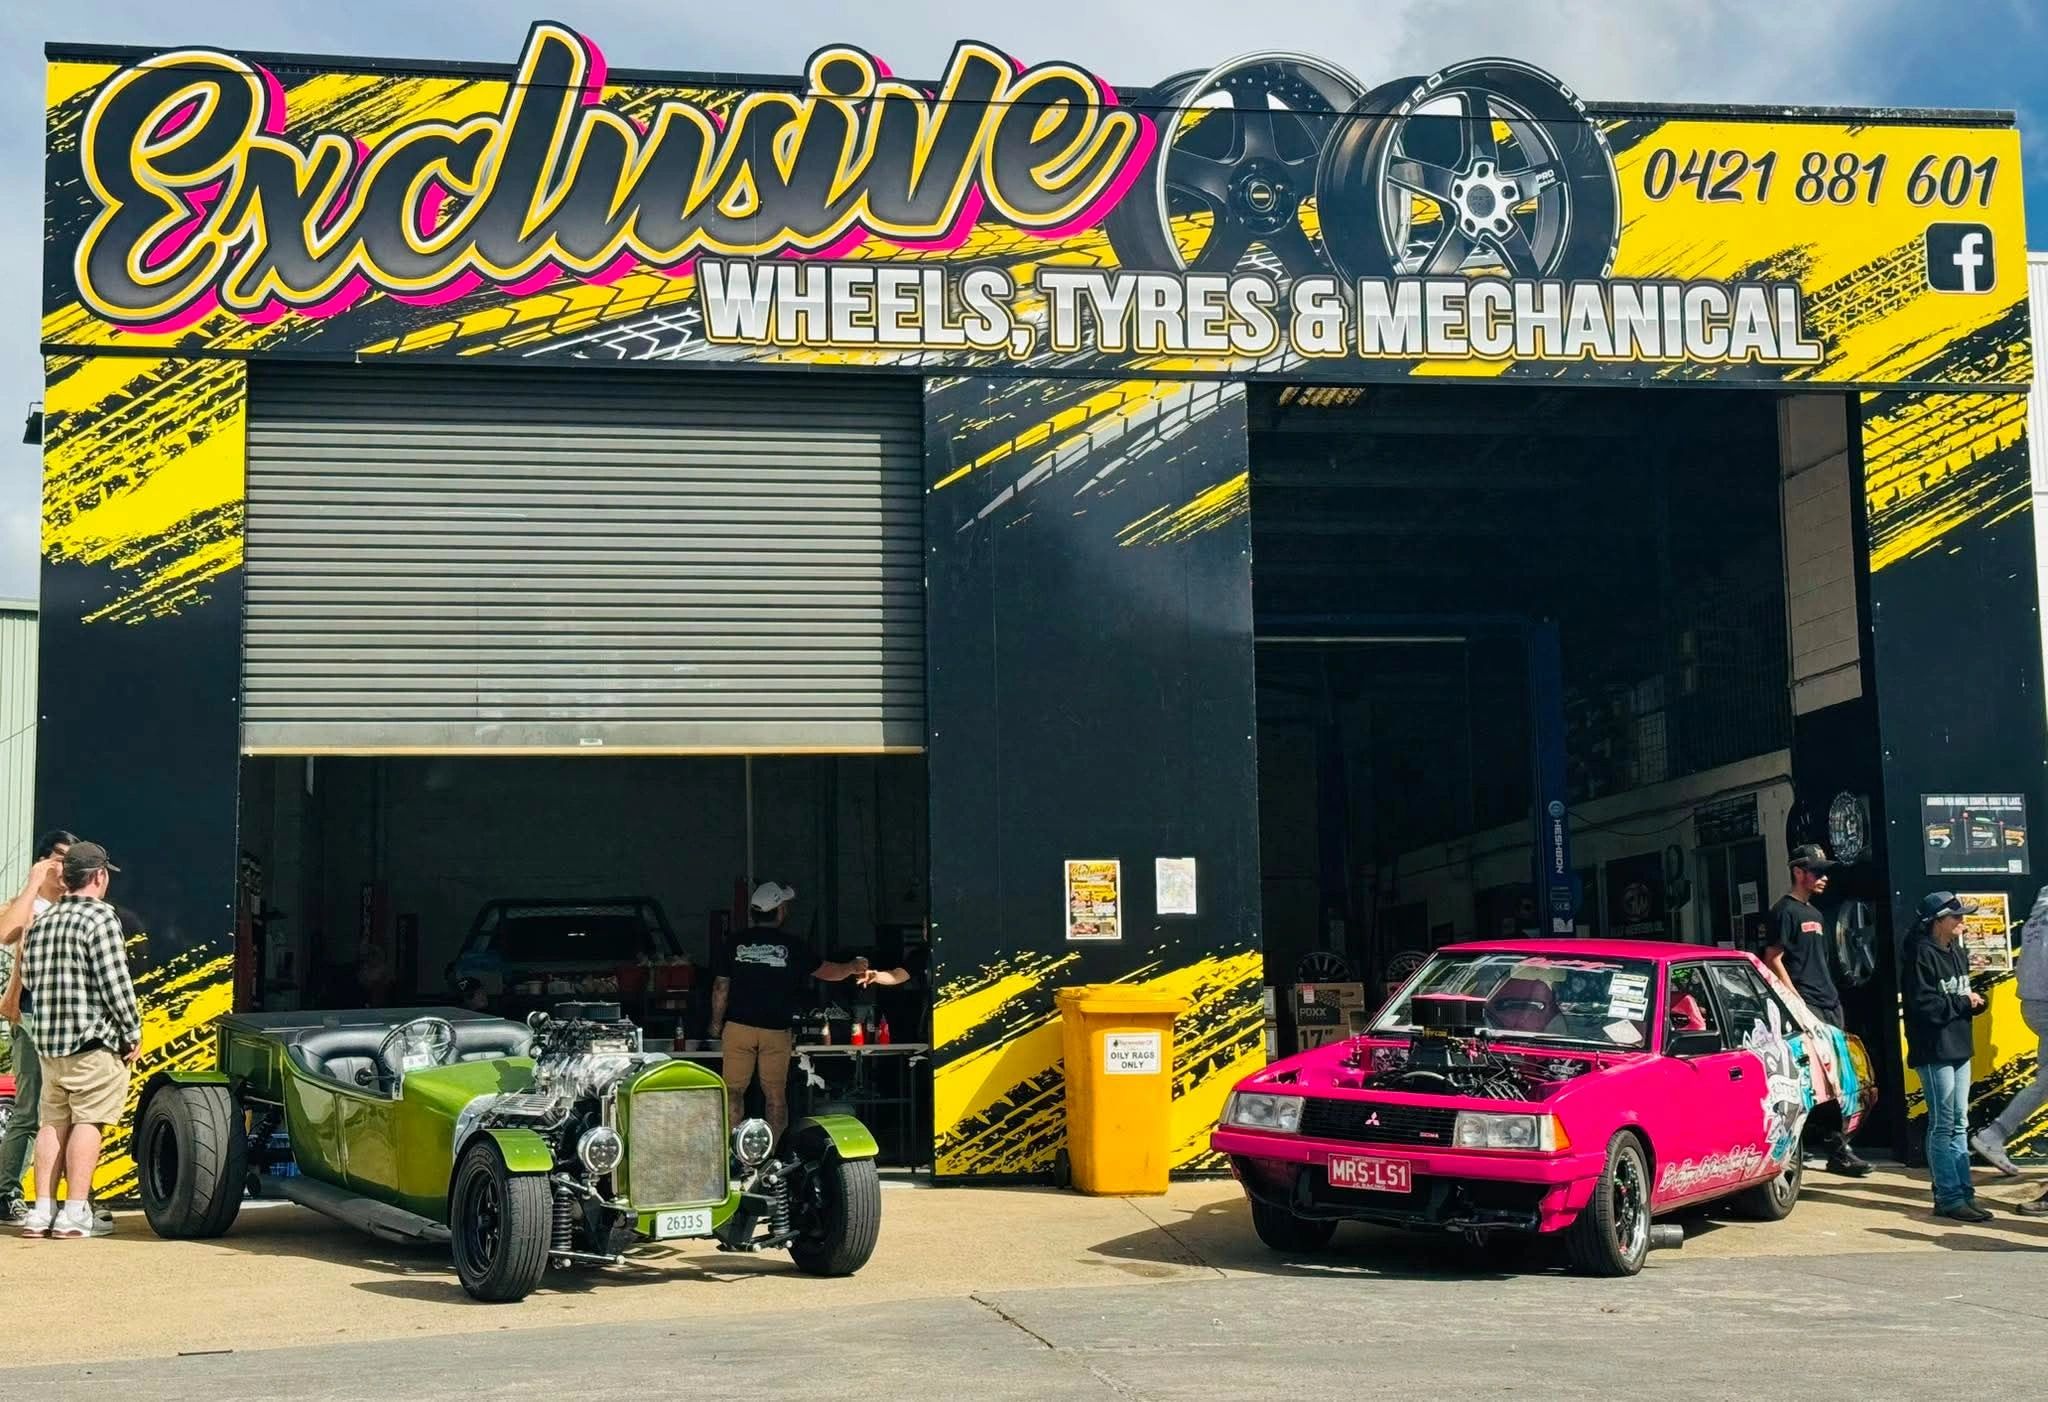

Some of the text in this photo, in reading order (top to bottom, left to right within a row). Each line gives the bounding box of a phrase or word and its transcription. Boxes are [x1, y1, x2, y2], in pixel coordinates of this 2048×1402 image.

[76, 22, 1148, 328] Exclusive
[1643, 147, 2000, 209] 0421 881 601
[701, 262, 1824, 365] WHEELS, TYRES & MECHANICAL
[1554, 819, 1565, 874] HESHBON
[1110, 1051, 1155, 1060] OILY RAGS
[1121, 1061, 1144, 1069] ONLY
[1332, 1158, 1407, 1187] MRS-LS1
